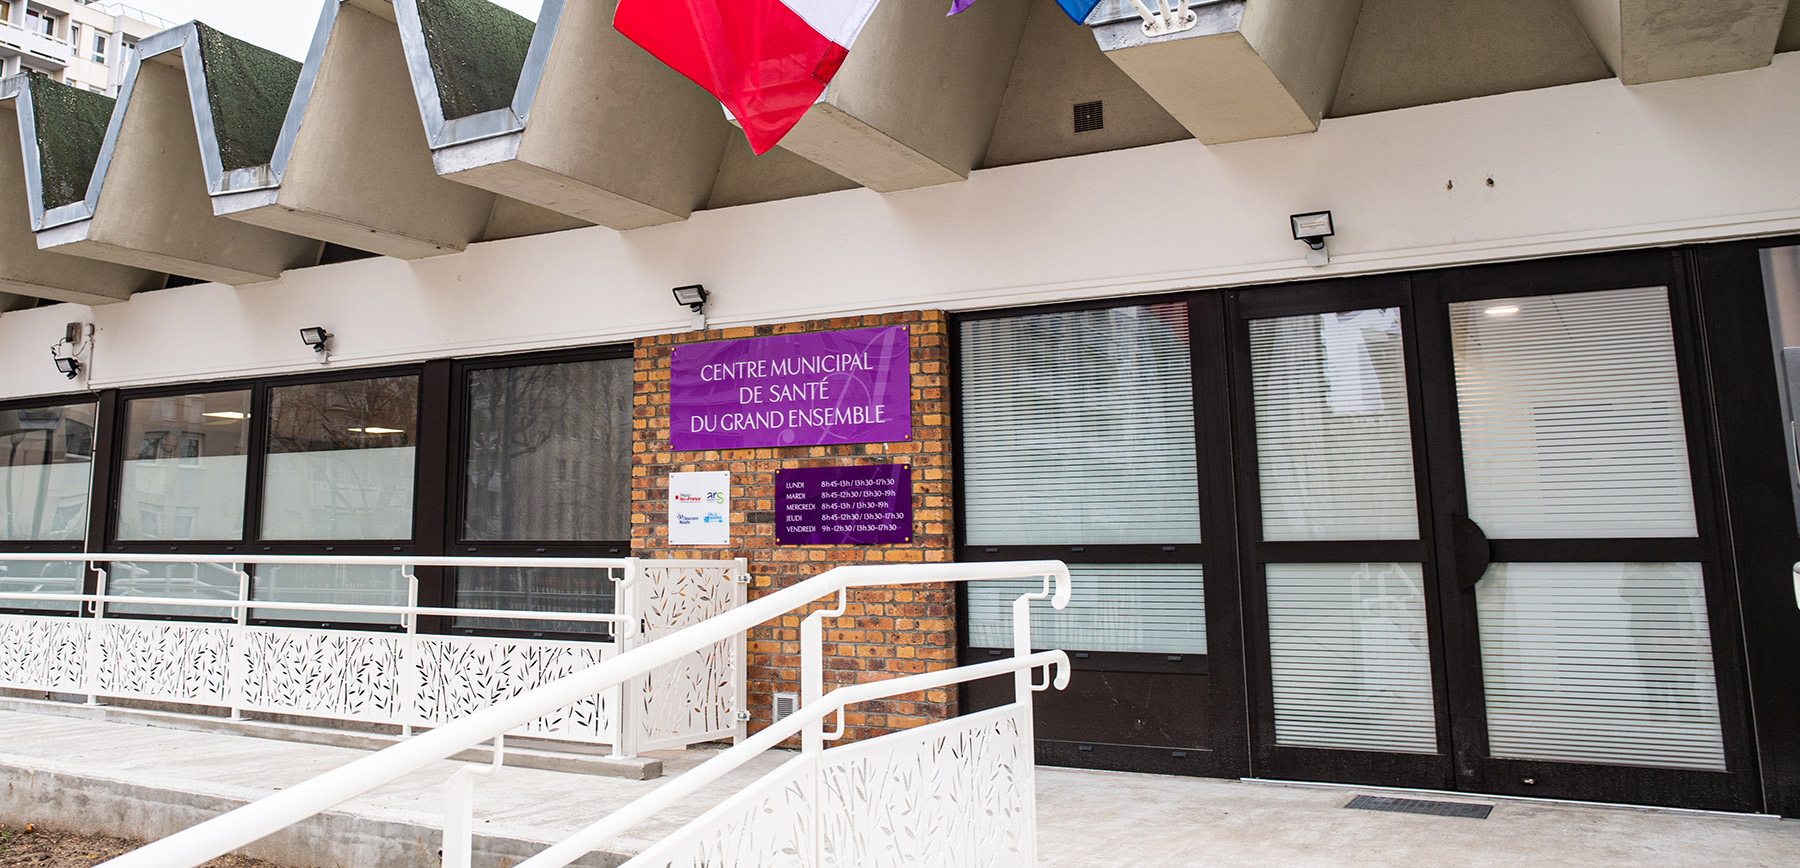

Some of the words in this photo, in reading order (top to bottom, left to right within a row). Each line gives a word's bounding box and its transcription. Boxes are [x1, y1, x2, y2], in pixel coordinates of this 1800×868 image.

[700, 360, 766, 382] CENTRE
[771, 352, 873, 376] MUNICIPAL
[739, 385, 763, 405] DE
[769, 377, 829, 403] SANTÉ
[691, 414, 717, 433] DU
[720, 410, 784, 430] GRAND
[788, 404, 885, 428] ENSEMBLE
[785, 481, 805, 489] LUNDI
[785, 492, 806, 500] MARDI
[785, 503, 816, 511] MERCREDI
[785, 514, 803, 522] JEUDI
[786, 525, 816, 533] VENDREDI
